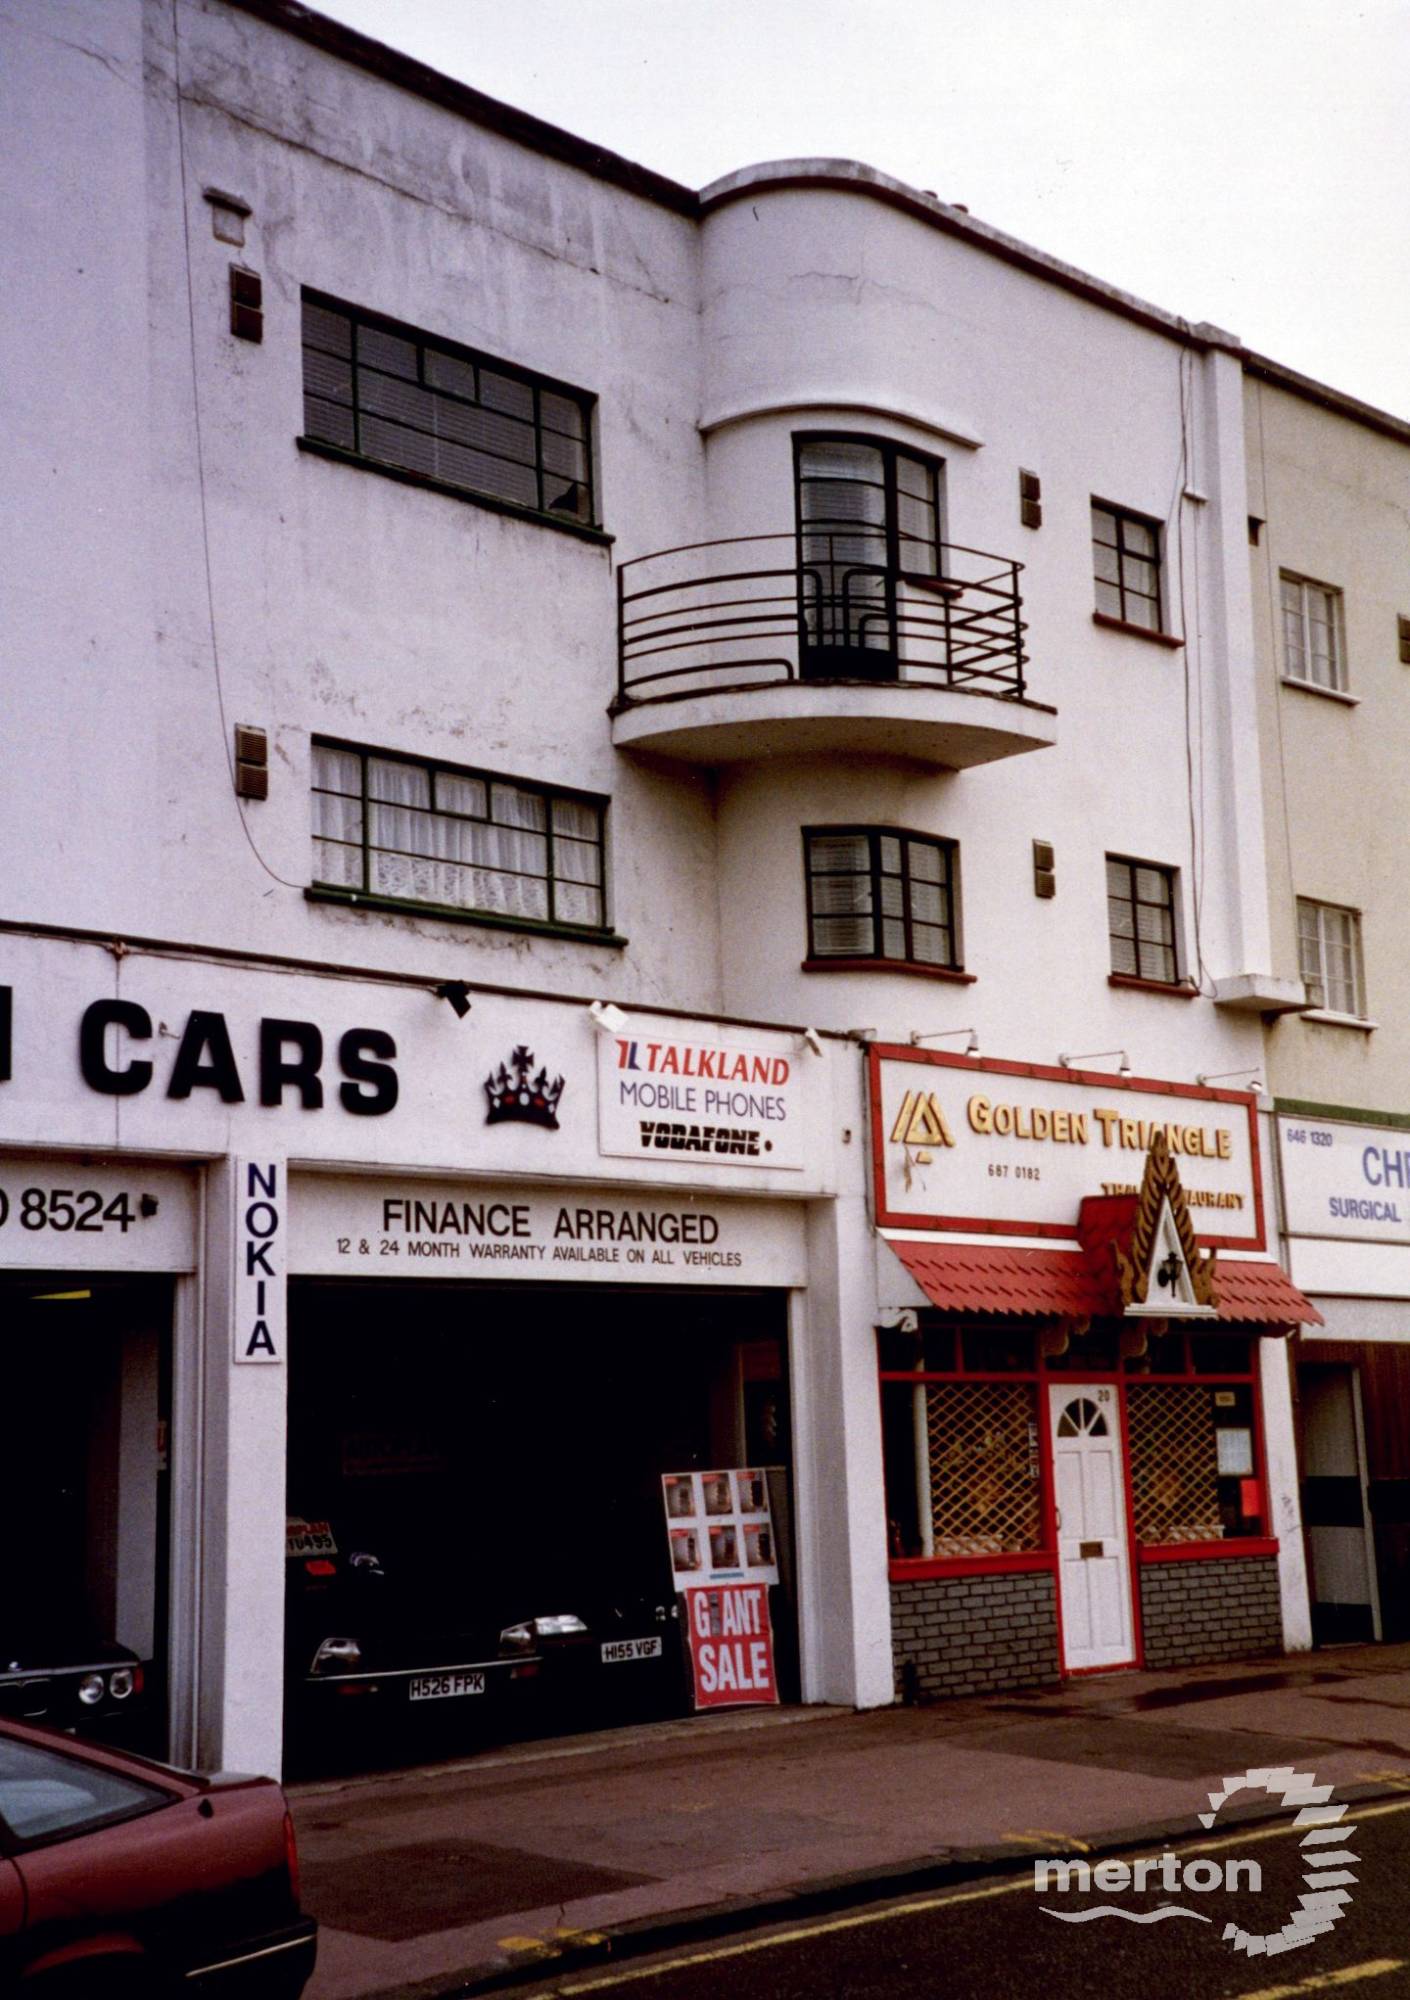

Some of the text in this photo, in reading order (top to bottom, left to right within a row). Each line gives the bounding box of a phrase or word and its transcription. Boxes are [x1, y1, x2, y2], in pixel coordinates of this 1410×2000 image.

[80, 998, 399, 1116] CARS
[647, 1043, 790, 1086] TALKLAND
[620, 1080, 786, 1121] MOBILE PHONES
[967, 1094, 1088, 1146] GOLDEN
[639, 1121, 760, 1156] VODAFONE
[1310, 1131, 1333, 1147] 1320
[20, 1187, 136, 1233] 8524
[384, 1199, 719, 1245] FINANCE ARRANGED
[1329, 1197, 1402, 1223] SURGICAL
[245, 1162, 279, 1356] NOKIA
[337, 1238, 742, 1267] 12 & 24 MONTH WARRANTY AVAILABLE ON ALL VEHICLES
[694, 1589, 761, 1638] GIANT
[410, 1674, 484, 1698] H526 FPK
[699, 1642, 769, 1693] SALE
